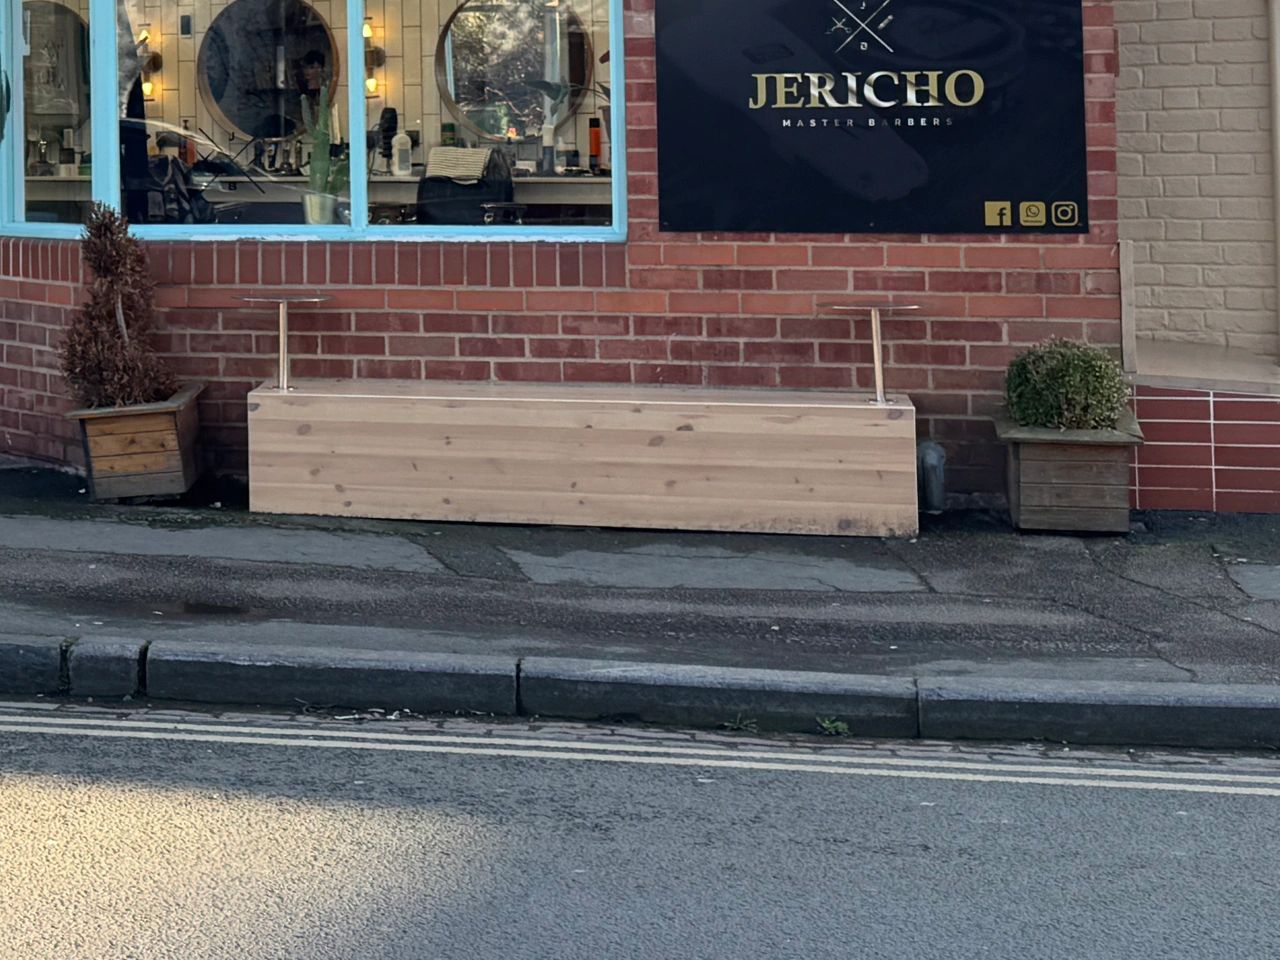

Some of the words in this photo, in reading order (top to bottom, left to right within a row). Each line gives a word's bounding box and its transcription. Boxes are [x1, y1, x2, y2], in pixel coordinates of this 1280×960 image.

[748, 69, 985, 109] JERICHO
[782, 118, 854, 128] MASTER
[868, 117, 953, 127] BARBERS
